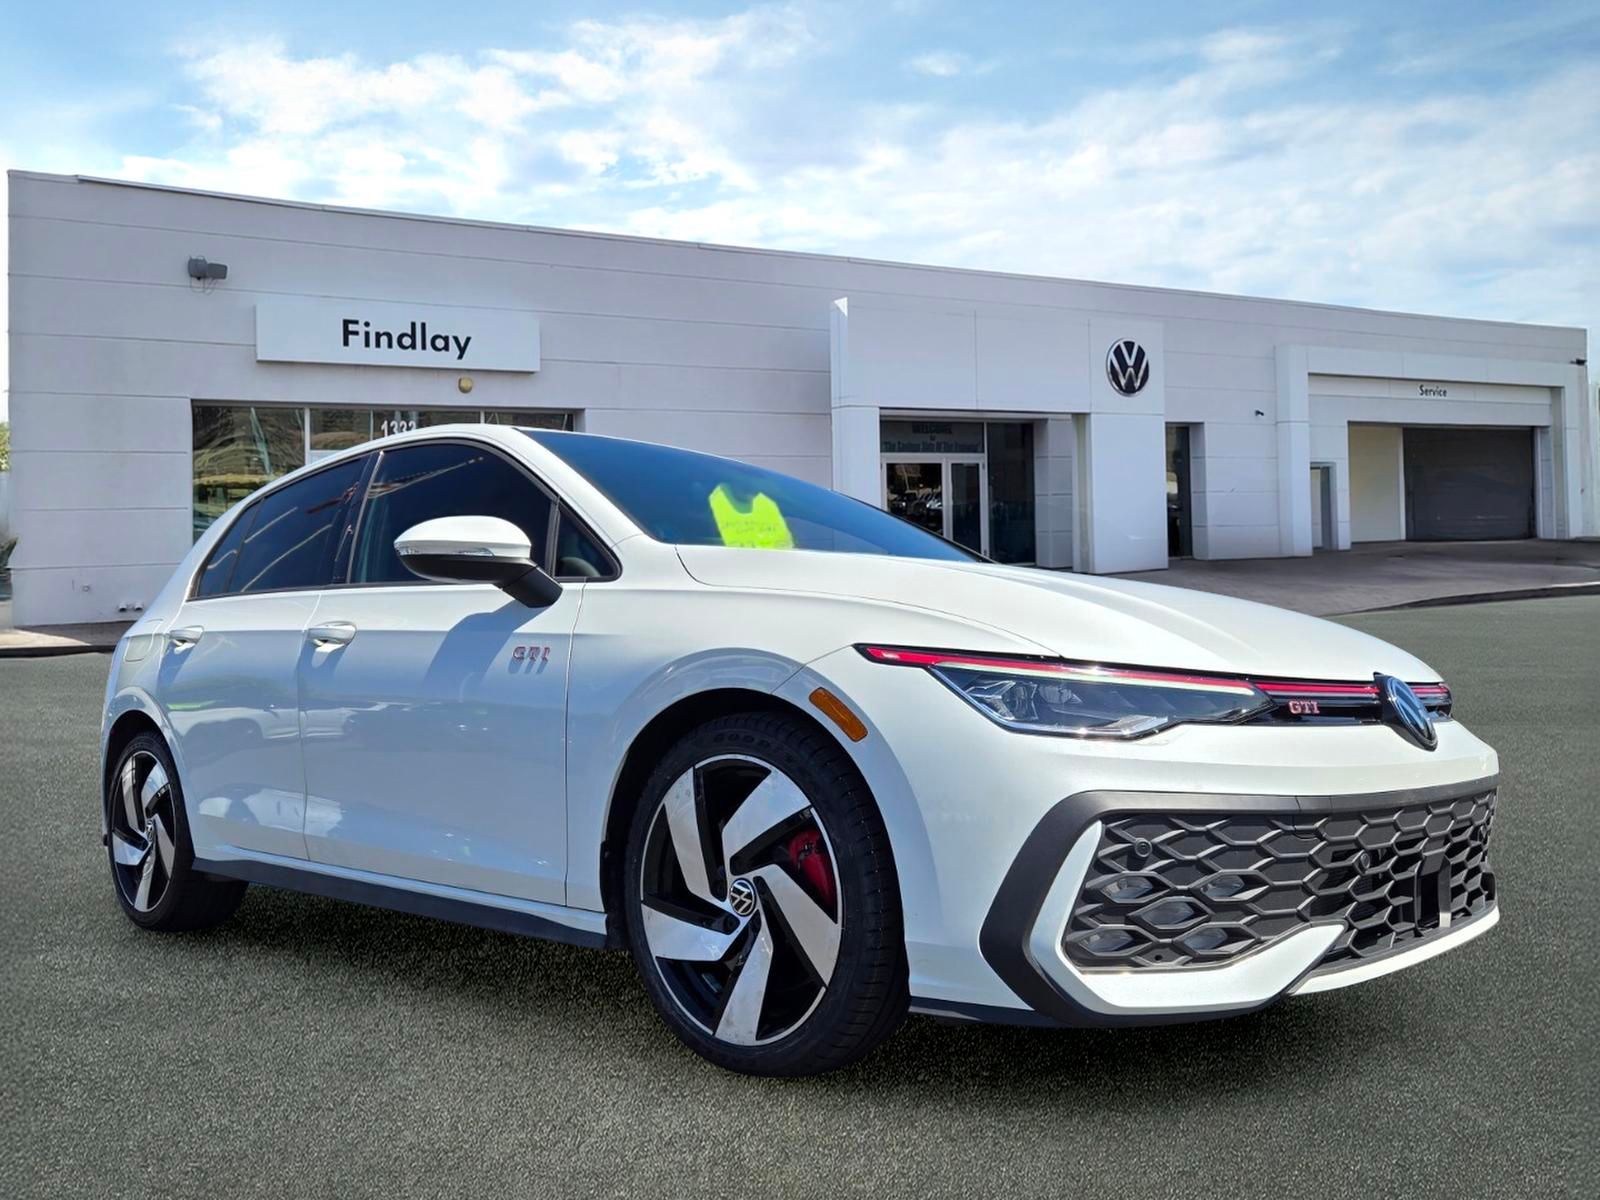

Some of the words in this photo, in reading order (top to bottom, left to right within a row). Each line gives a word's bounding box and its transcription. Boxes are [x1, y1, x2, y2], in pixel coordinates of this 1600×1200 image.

[342, 318, 472, 360] Findlay
[1107, 338, 1149, 395] VW
[1419, 384, 1447, 398] Service
[512, 646, 551, 662] GTI
[1289, 700, 1320, 714] GTI
